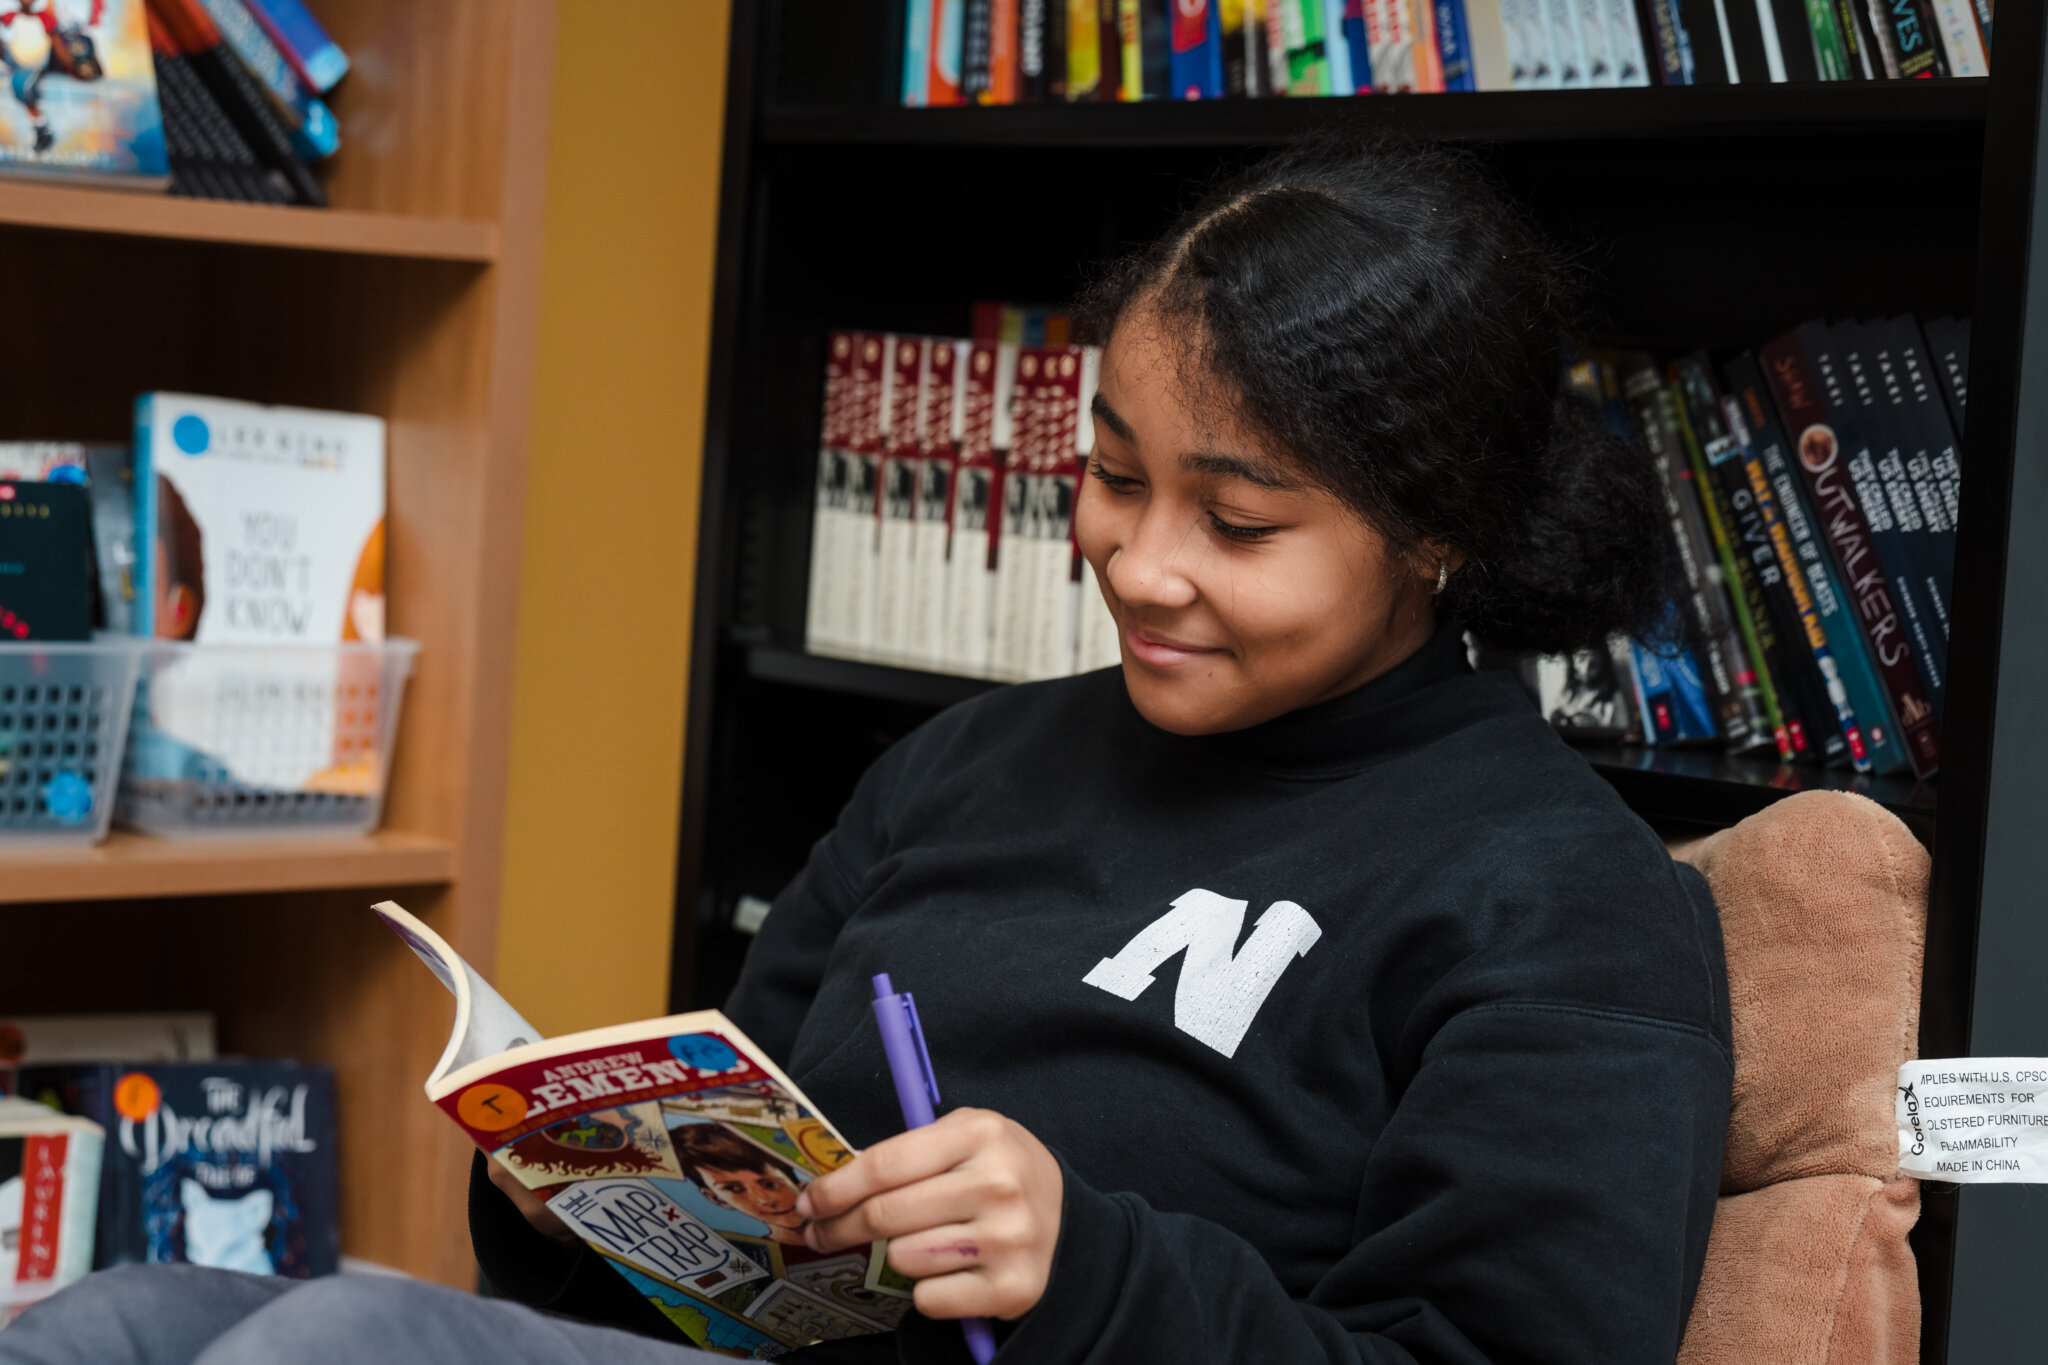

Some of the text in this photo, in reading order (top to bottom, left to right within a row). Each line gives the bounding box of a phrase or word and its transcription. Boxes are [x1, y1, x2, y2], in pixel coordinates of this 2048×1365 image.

[1890, 0, 1923, 52] VES
[1818, 353, 1843, 406] TAKEI
[1848, 352, 1873, 405] TAKEI
[1877, 351, 1903, 404] TAKEI
[1903, 348, 1928, 402] TAKEI
[1762, 442, 1785, 474] THE
[1932, 456, 1949, 481] US
[1849, 457, 1883, 532] US ENEMY
[1878, 457, 1913, 532] US ENEMY
[1907, 457, 1942, 532] US ENEMY
[239, 509, 298, 553] YOU
[1732, 488, 1781, 586] GIVER
[1798, 422, 1909, 666] OUTWALKERS
[1800, 541, 1819, 560] OF
[224, 593, 315, 637] KNOW
[1807, 562, 1838, 617] BEASTS
[1081, 888, 1323, 1059] N
[543, 1051, 642, 1083] ANDREW
[1958, 1072, 1988, 1083] WITH
[1991, 1071, 2013, 1083] U.S.
[2016, 1070, 2048, 1083] CPSC
[1924, 1092, 2035, 1108] EQUIREMENTS FOR
[1988, 1114, 2048, 1127] FURNITURE
[1936, 1159, 2021, 1172] MADE IN CHINA
[1940, 1136, 2018, 1152] FLAMMABILITY
[558, 1190, 598, 1220] THE
[580, 1191, 669, 1253] MAP
[628, 1222, 720, 1277] TRAP
